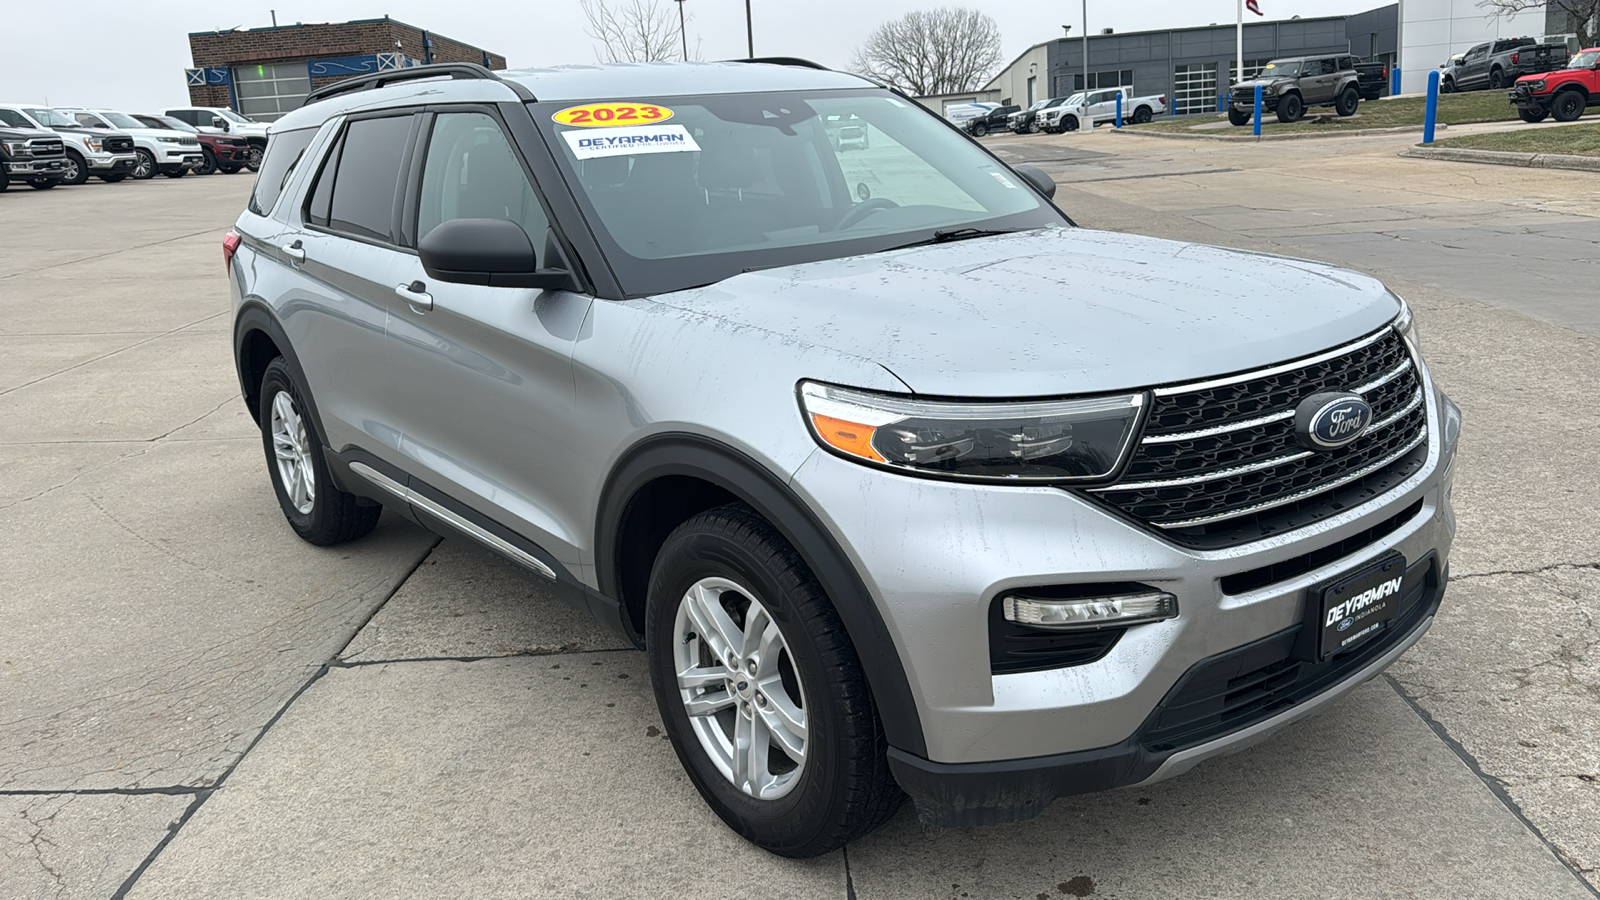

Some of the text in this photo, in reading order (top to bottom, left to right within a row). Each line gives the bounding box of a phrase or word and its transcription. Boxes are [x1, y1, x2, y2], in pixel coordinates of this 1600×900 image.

[569, 107, 662, 123] 2023
[578, 134, 684, 147] DEYARMAN
[589, 143, 635, 151] CERTIFIED
[1329, 406, 1363, 437] Ford
[1325, 576, 1402, 628] DEYARMAN
[1355, 601, 1386, 621] INDIANOLA
